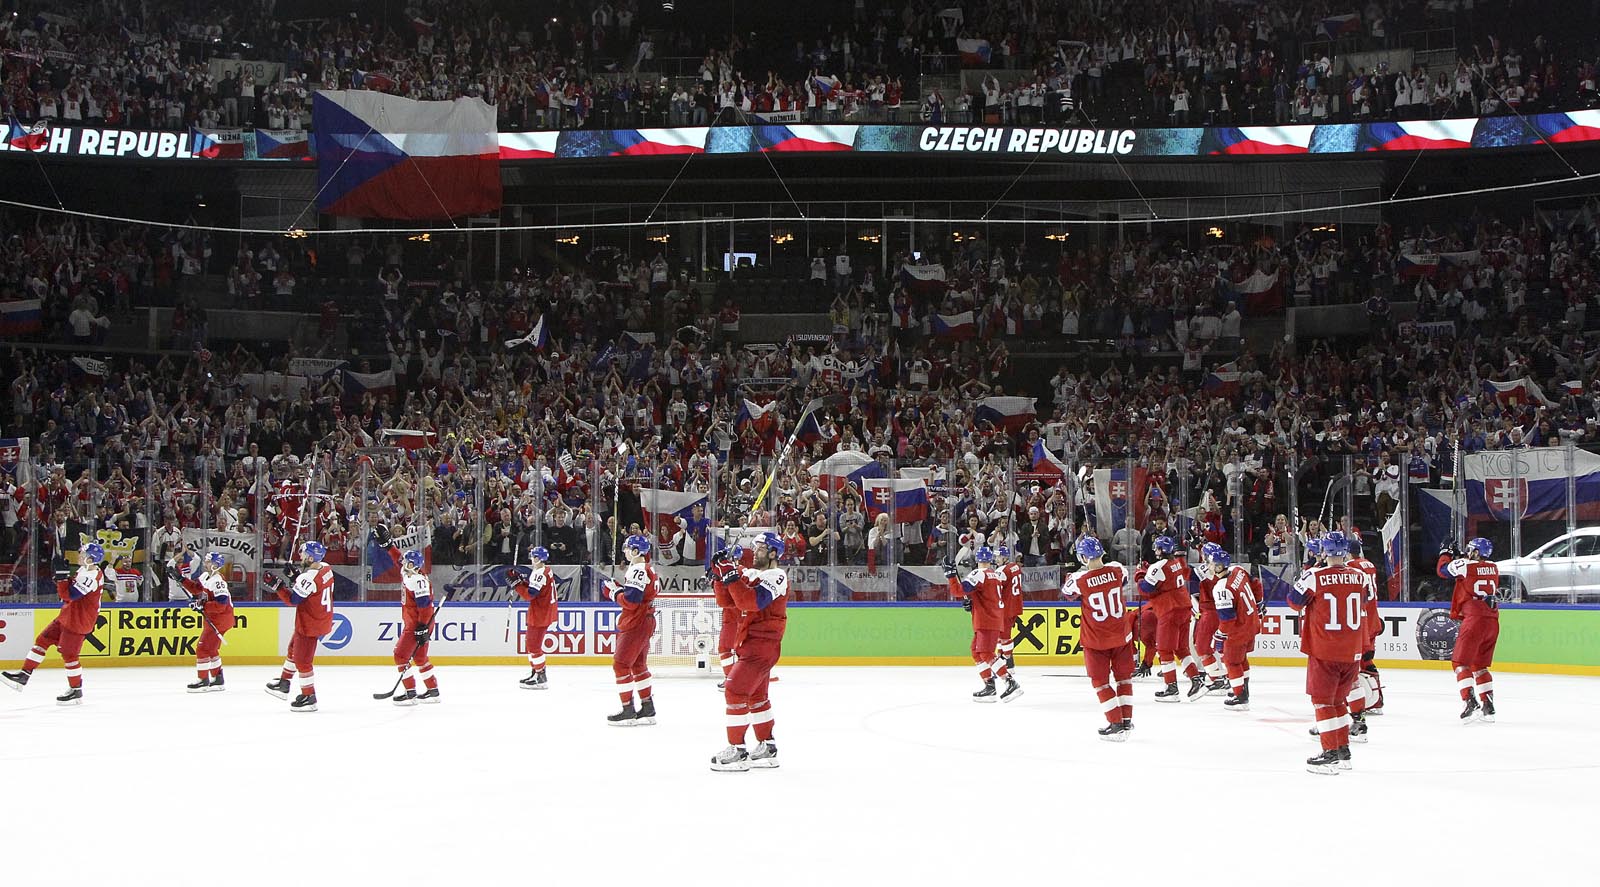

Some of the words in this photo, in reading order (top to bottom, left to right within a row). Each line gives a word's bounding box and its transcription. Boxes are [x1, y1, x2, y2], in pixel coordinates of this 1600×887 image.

[919, 127, 1002, 152] CZECH
[1007, 128, 1136, 155] REPUBLIC
[82, 576, 94, 588] 11
[533, 573, 544, 583] 18
[633, 569, 645, 581] 72
[775, 574, 785, 586] 3
[1086, 571, 1117, 588] KOUSAL
[215, 581, 226, 590] 26
[300, 578, 312, 591] 47
[321, 582, 333, 613] 4
[1217, 590, 1228, 601] 14
[1087, 587, 1124, 622] 90
[1323, 592, 1361, 631] 10
[118, 608, 248, 629] Raiffein
[377, 622, 477, 641] ZICH
[118, 636, 200, 657] BANK
[1383, 642, 1408, 652] 1853
